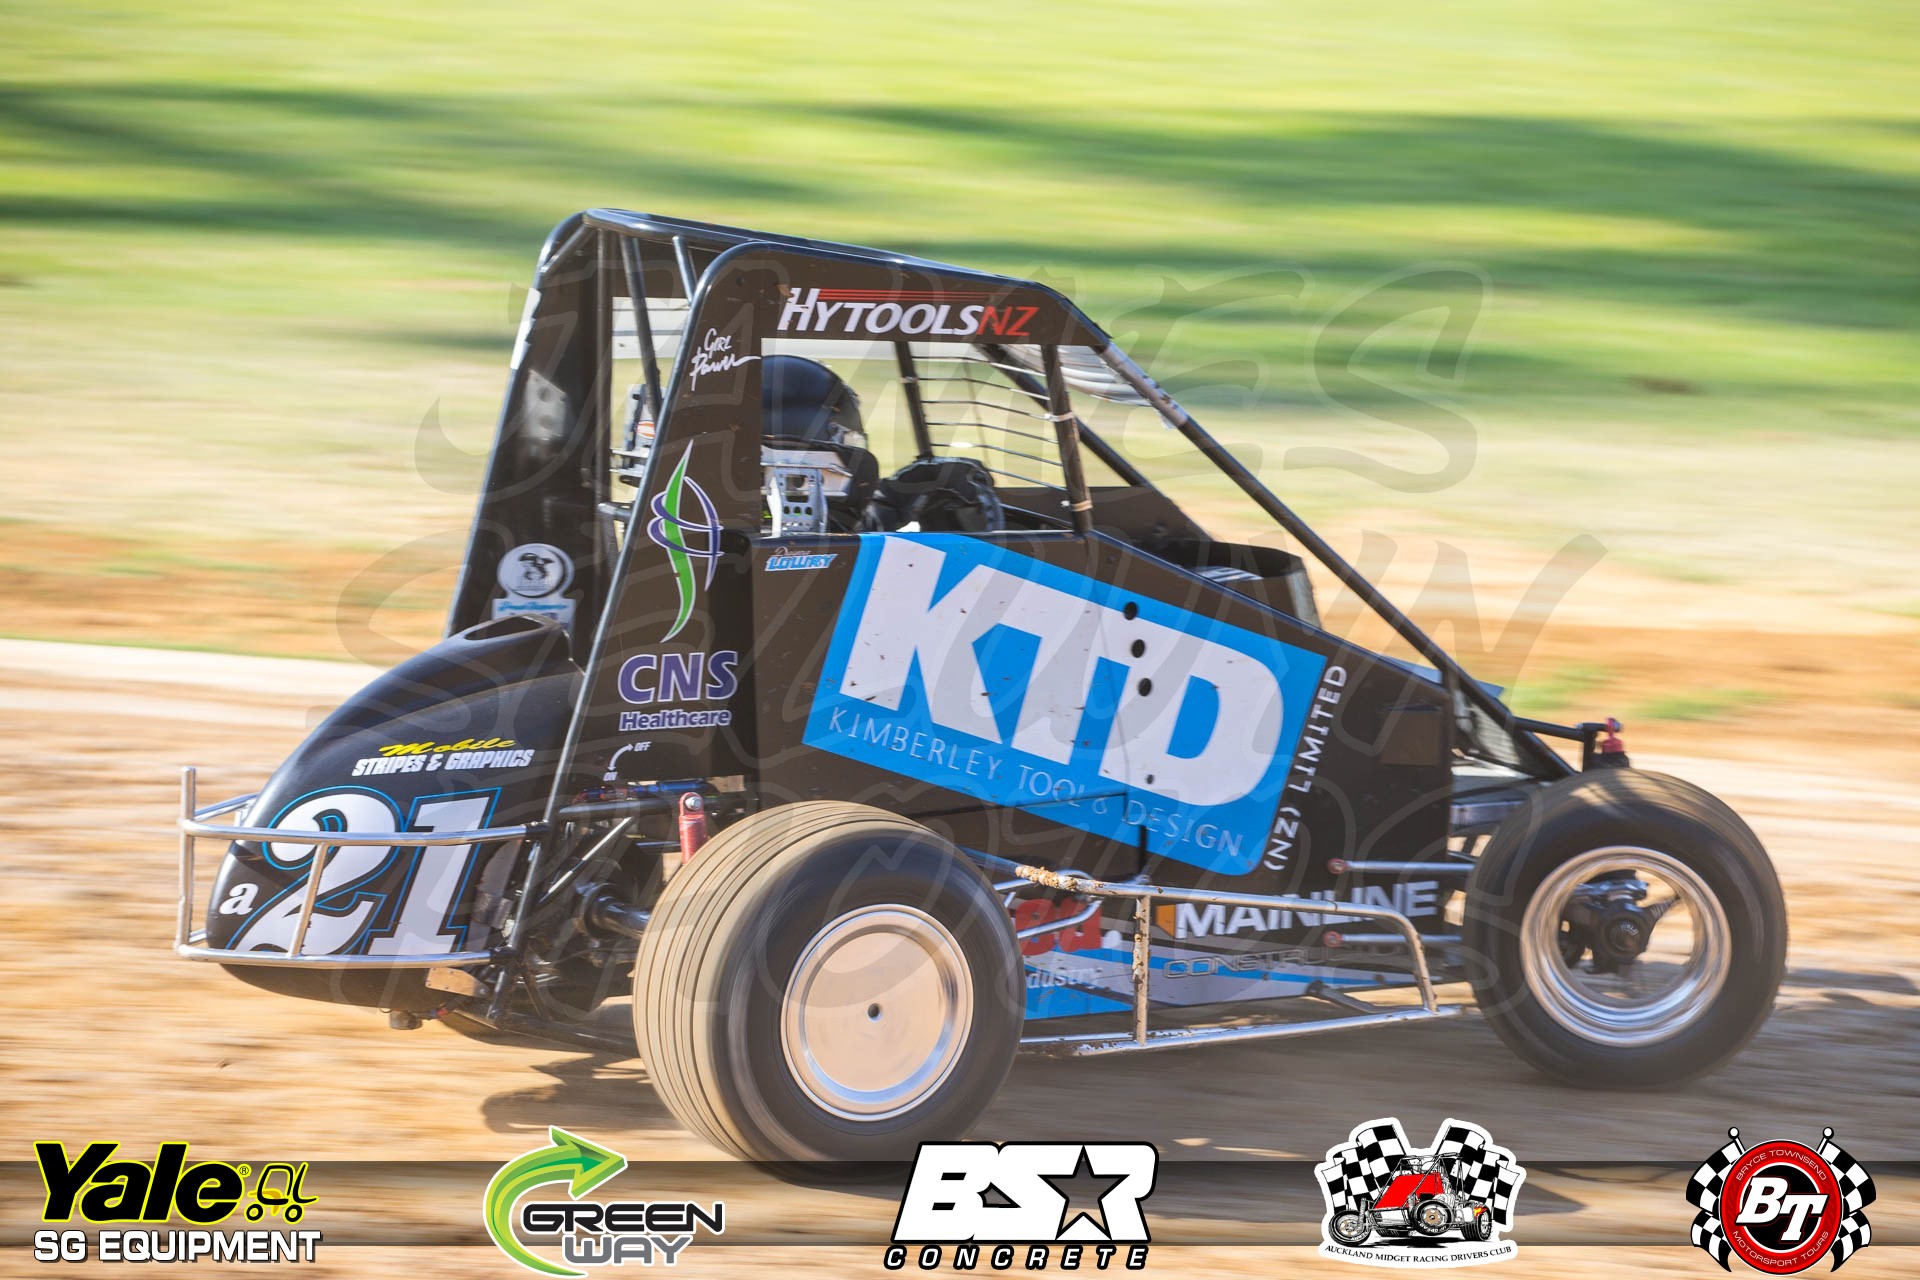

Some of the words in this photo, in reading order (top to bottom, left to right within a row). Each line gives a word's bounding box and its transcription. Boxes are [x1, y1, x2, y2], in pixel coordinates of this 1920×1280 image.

[765, 554, 838, 571] LOWRY
[618, 651, 738, 704] CNS
[840, 535, 1283, 806] KTD
[619, 709, 732, 731] Healthcare
[379, 738, 516, 757] Mobile
[634, 741, 652, 751] OFF
[352, 754, 427, 776] STRIPES
[426, 754, 444, 771] &
[445, 750, 535, 770] GRAPHICS
[1263, 806, 1302, 871] (NZ)
[1288, 665, 1348, 793] LIMITED
[829, 706, 1003, 781] KIMBERLEY
[1019, 764, 1086, 808] TOOL
[1122, 799, 1244, 857] DESIGN
[230, 788, 500, 955] 21
[219, 883, 259, 914] a
[1175, 881, 1438, 938] MAINLINE
[1024, 968, 1106, 989] dustry
